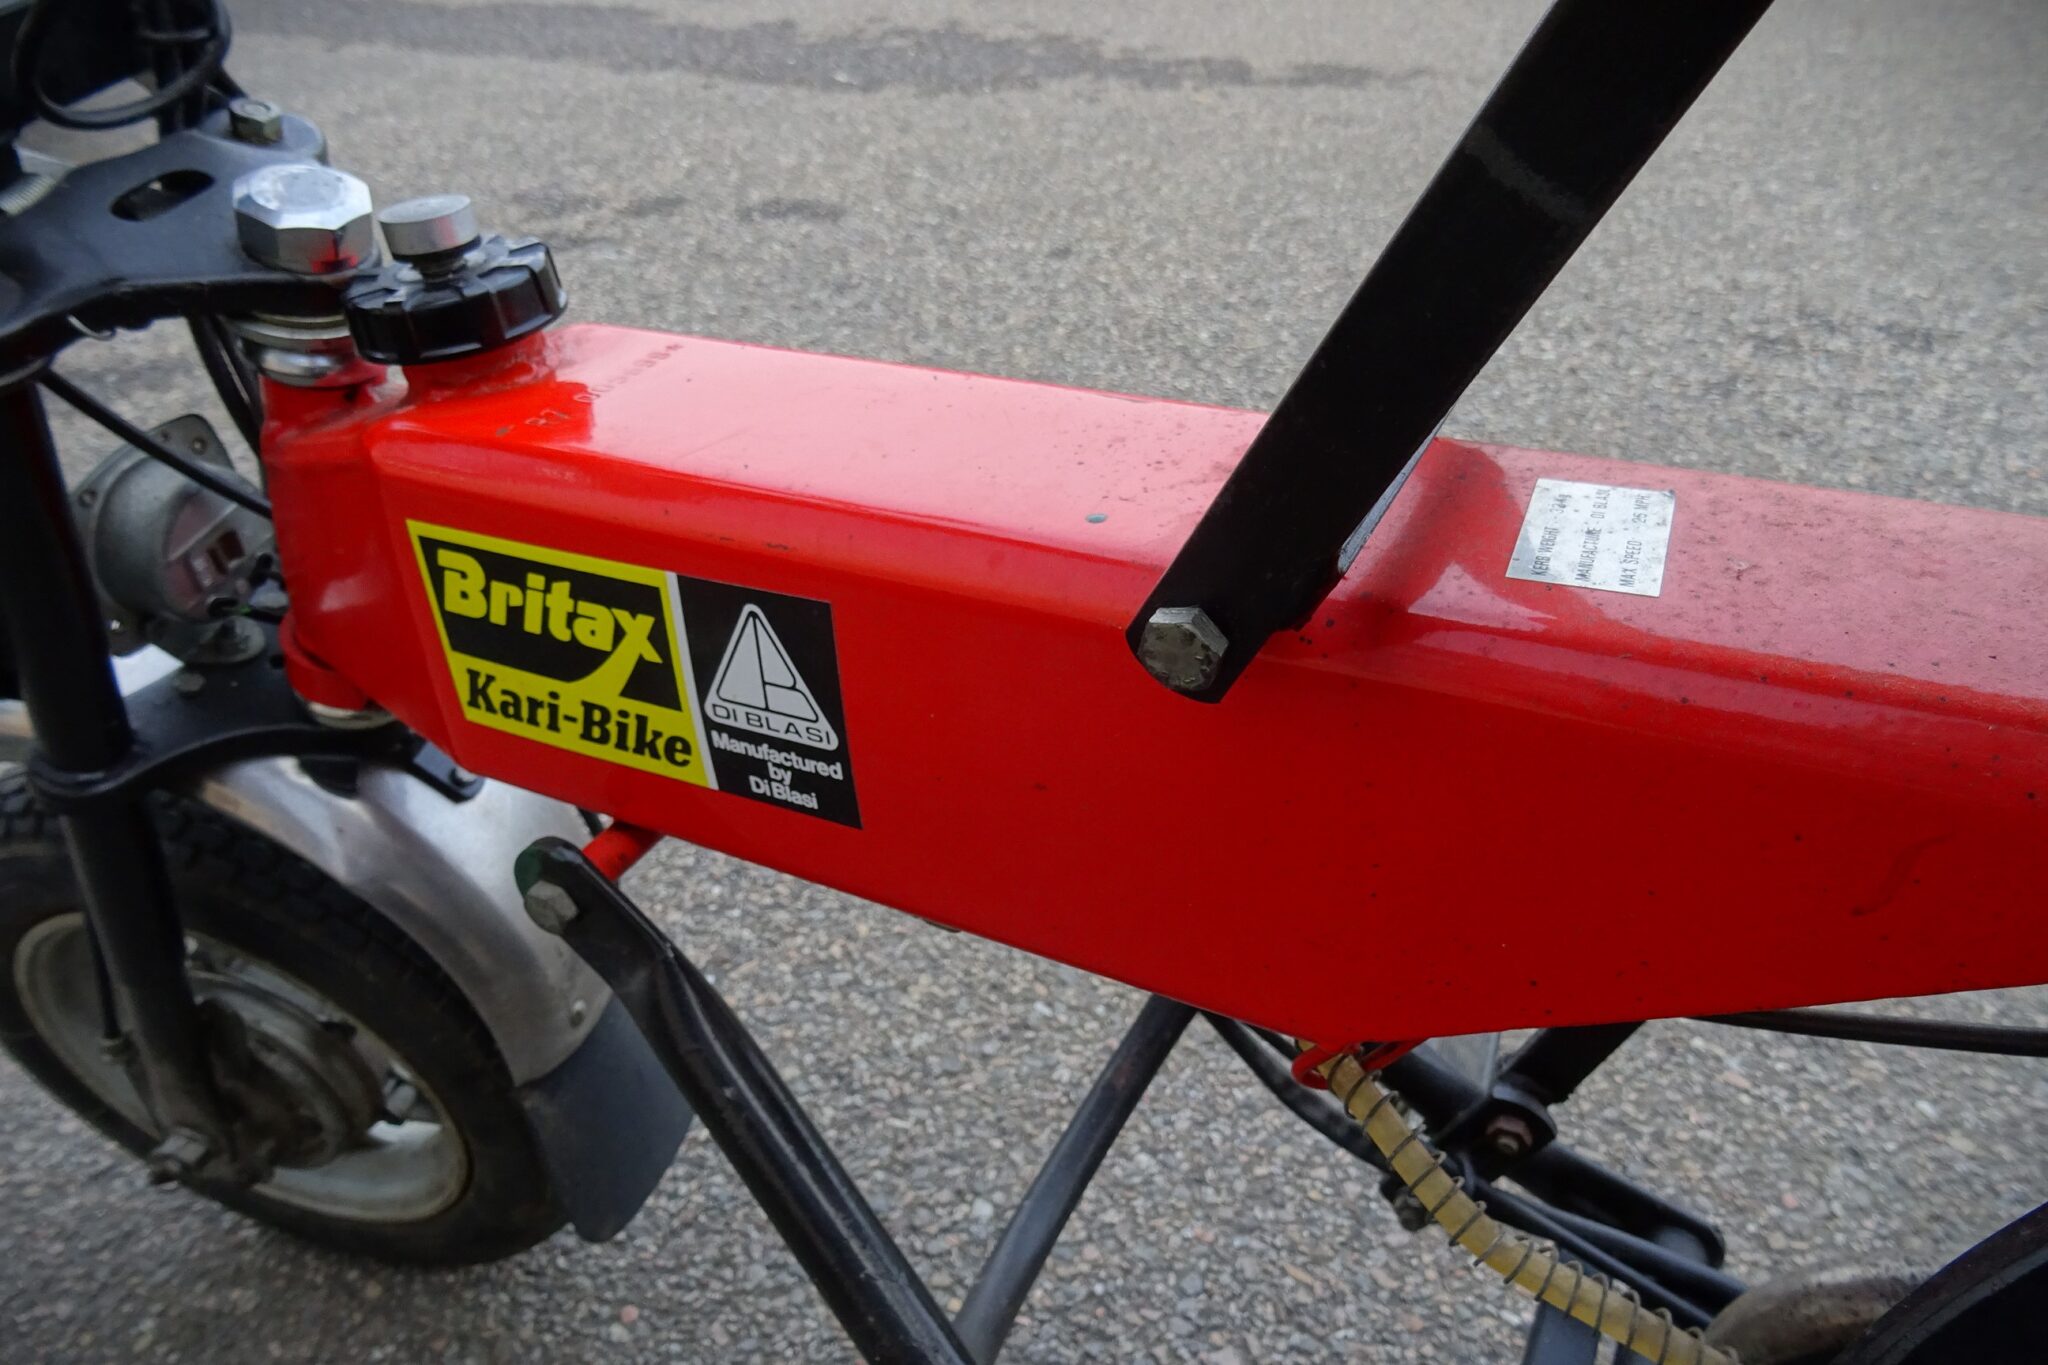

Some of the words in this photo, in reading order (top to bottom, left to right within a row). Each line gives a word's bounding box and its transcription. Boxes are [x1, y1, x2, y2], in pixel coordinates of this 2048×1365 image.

[1633, 494, 1649, 511] MPH
[1632, 512, 1647, 524] 25
[1537, 526, 1560, 553] WEIGHT
[1575, 527, 1602, 582] MANUFACTURE
[1590, 509, 1605, 519] DI
[1621, 540, 1642, 565] SPEED
[1530, 555, 1550, 576] KERB
[1619, 567, 1637, 587] MAX
[437, 548, 663, 686] Britax
[466, 668, 693, 768] Kari-Bike
[712, 703, 739, 722] DI
[745, 711, 831, 745] BLASI
[711, 729, 844, 781] Manufactured
[767, 761, 793, 786] by
